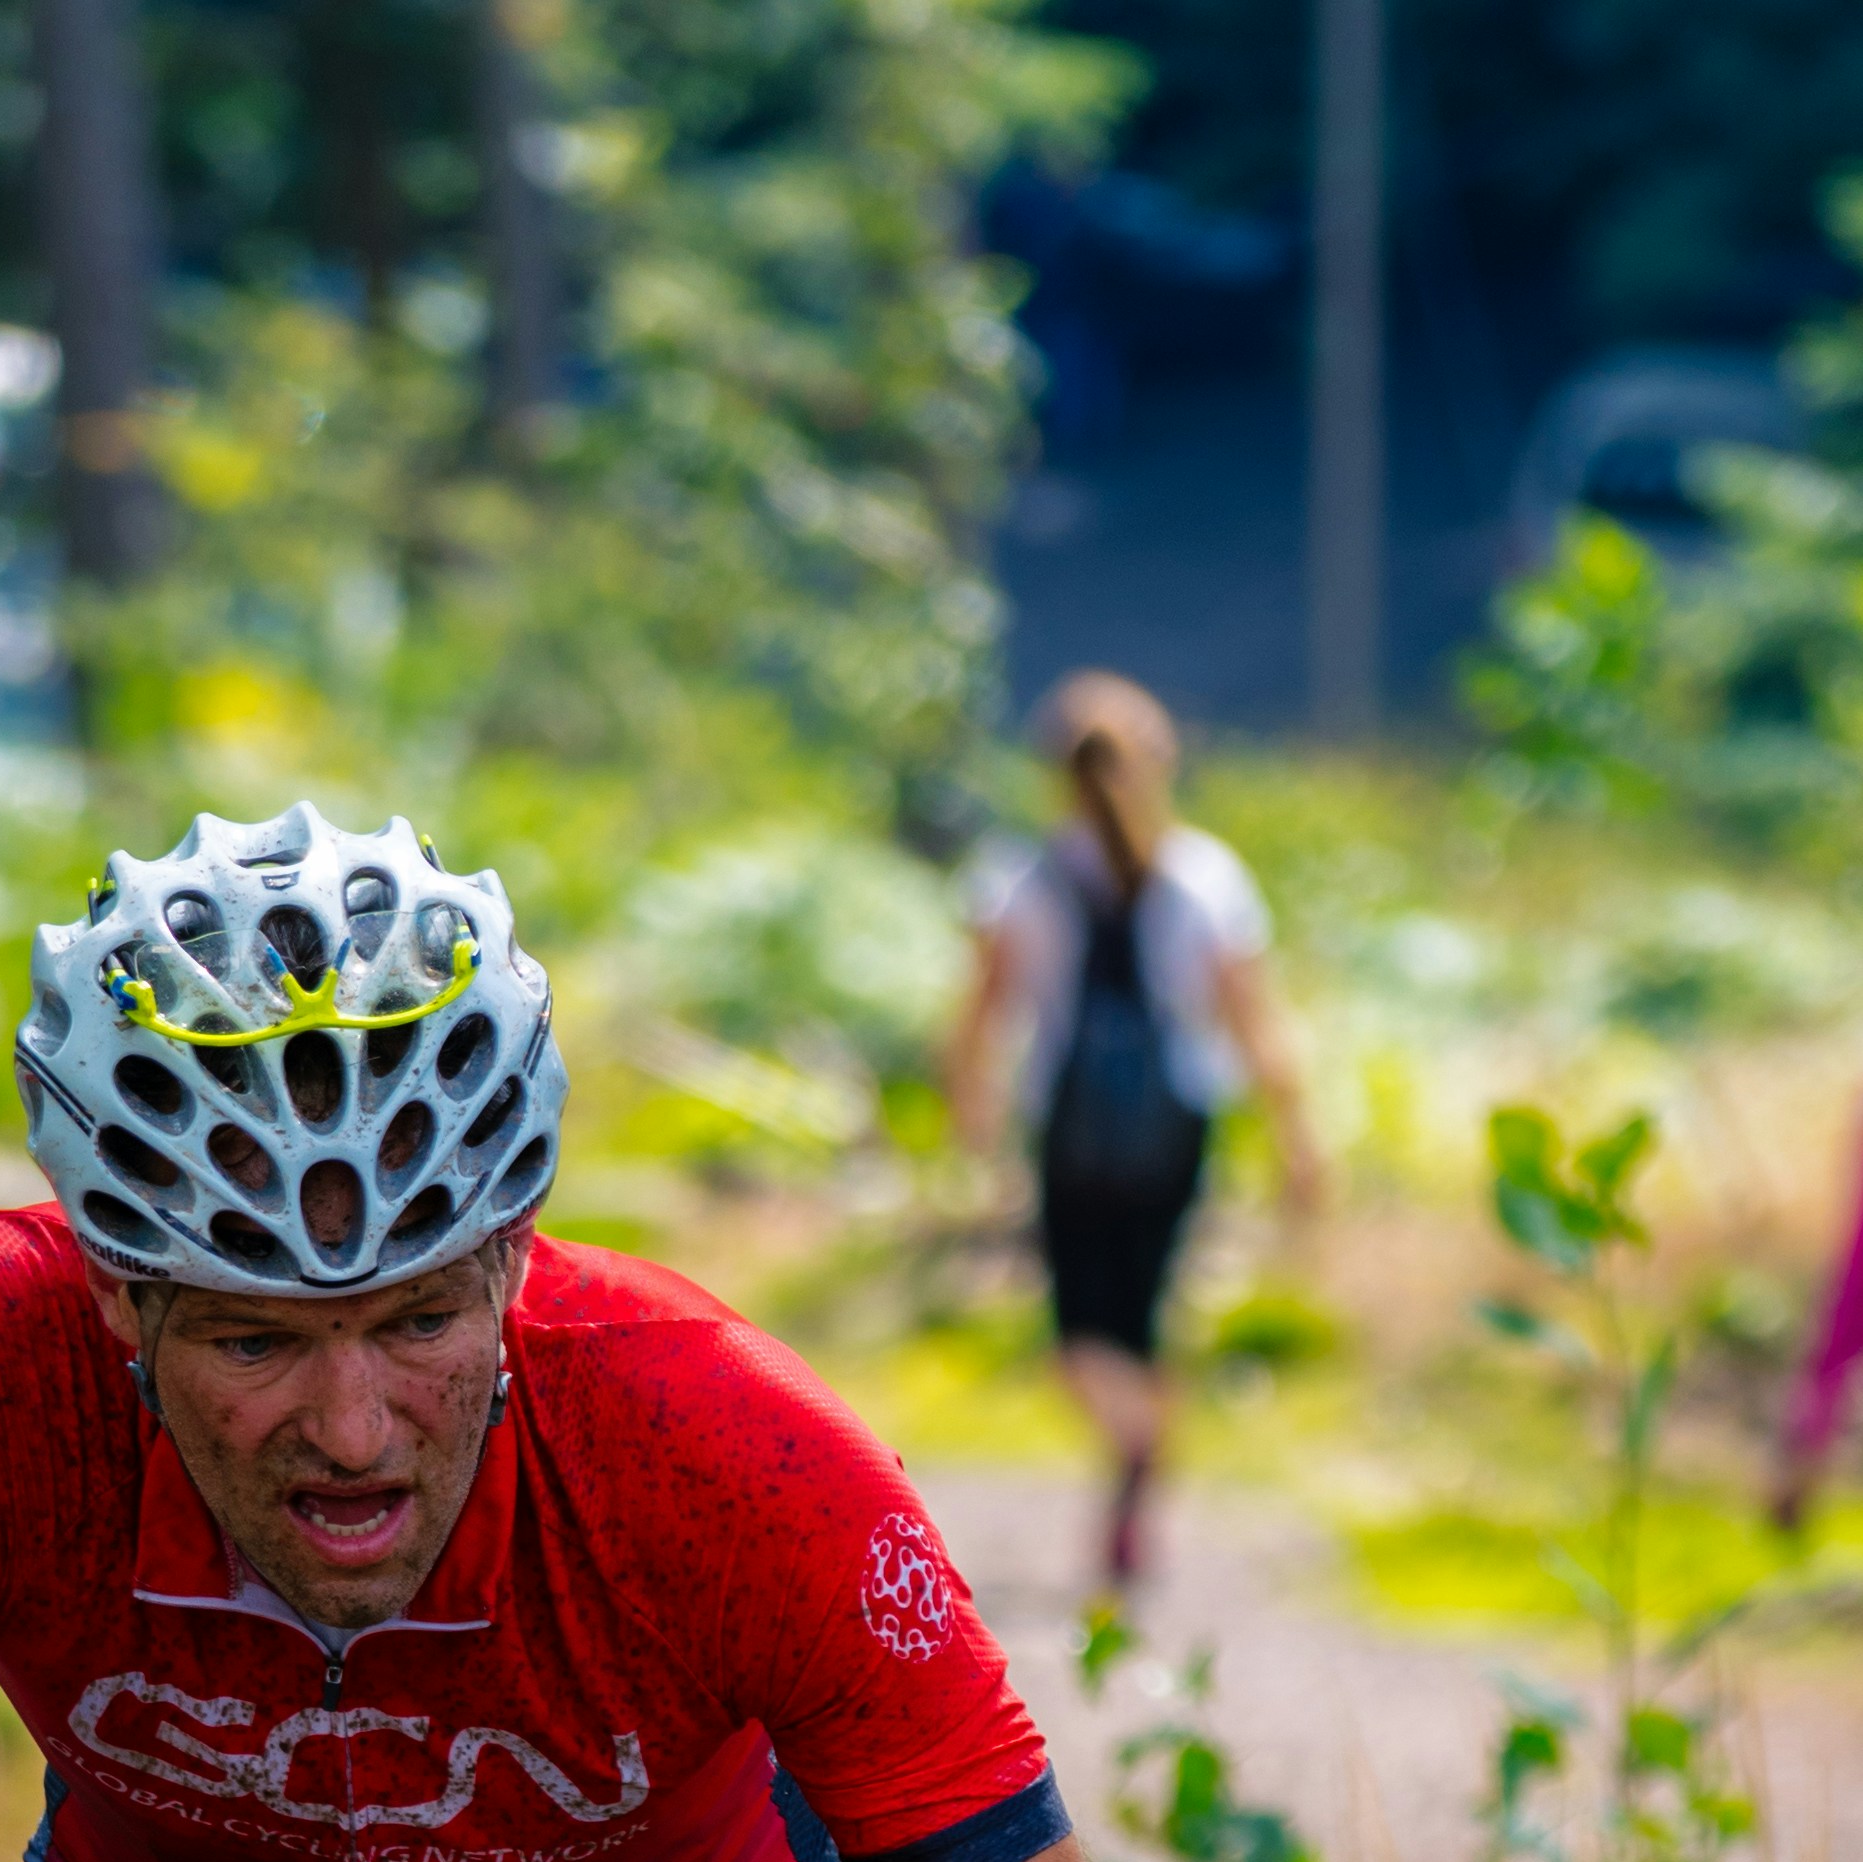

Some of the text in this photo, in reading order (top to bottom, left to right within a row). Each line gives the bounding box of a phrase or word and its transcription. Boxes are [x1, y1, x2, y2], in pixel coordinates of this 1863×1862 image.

[77, 1231, 172, 1281] catlike
[45, 1734, 213, 1827] GLOBAL
[67, 1671, 651, 1831] GCN
